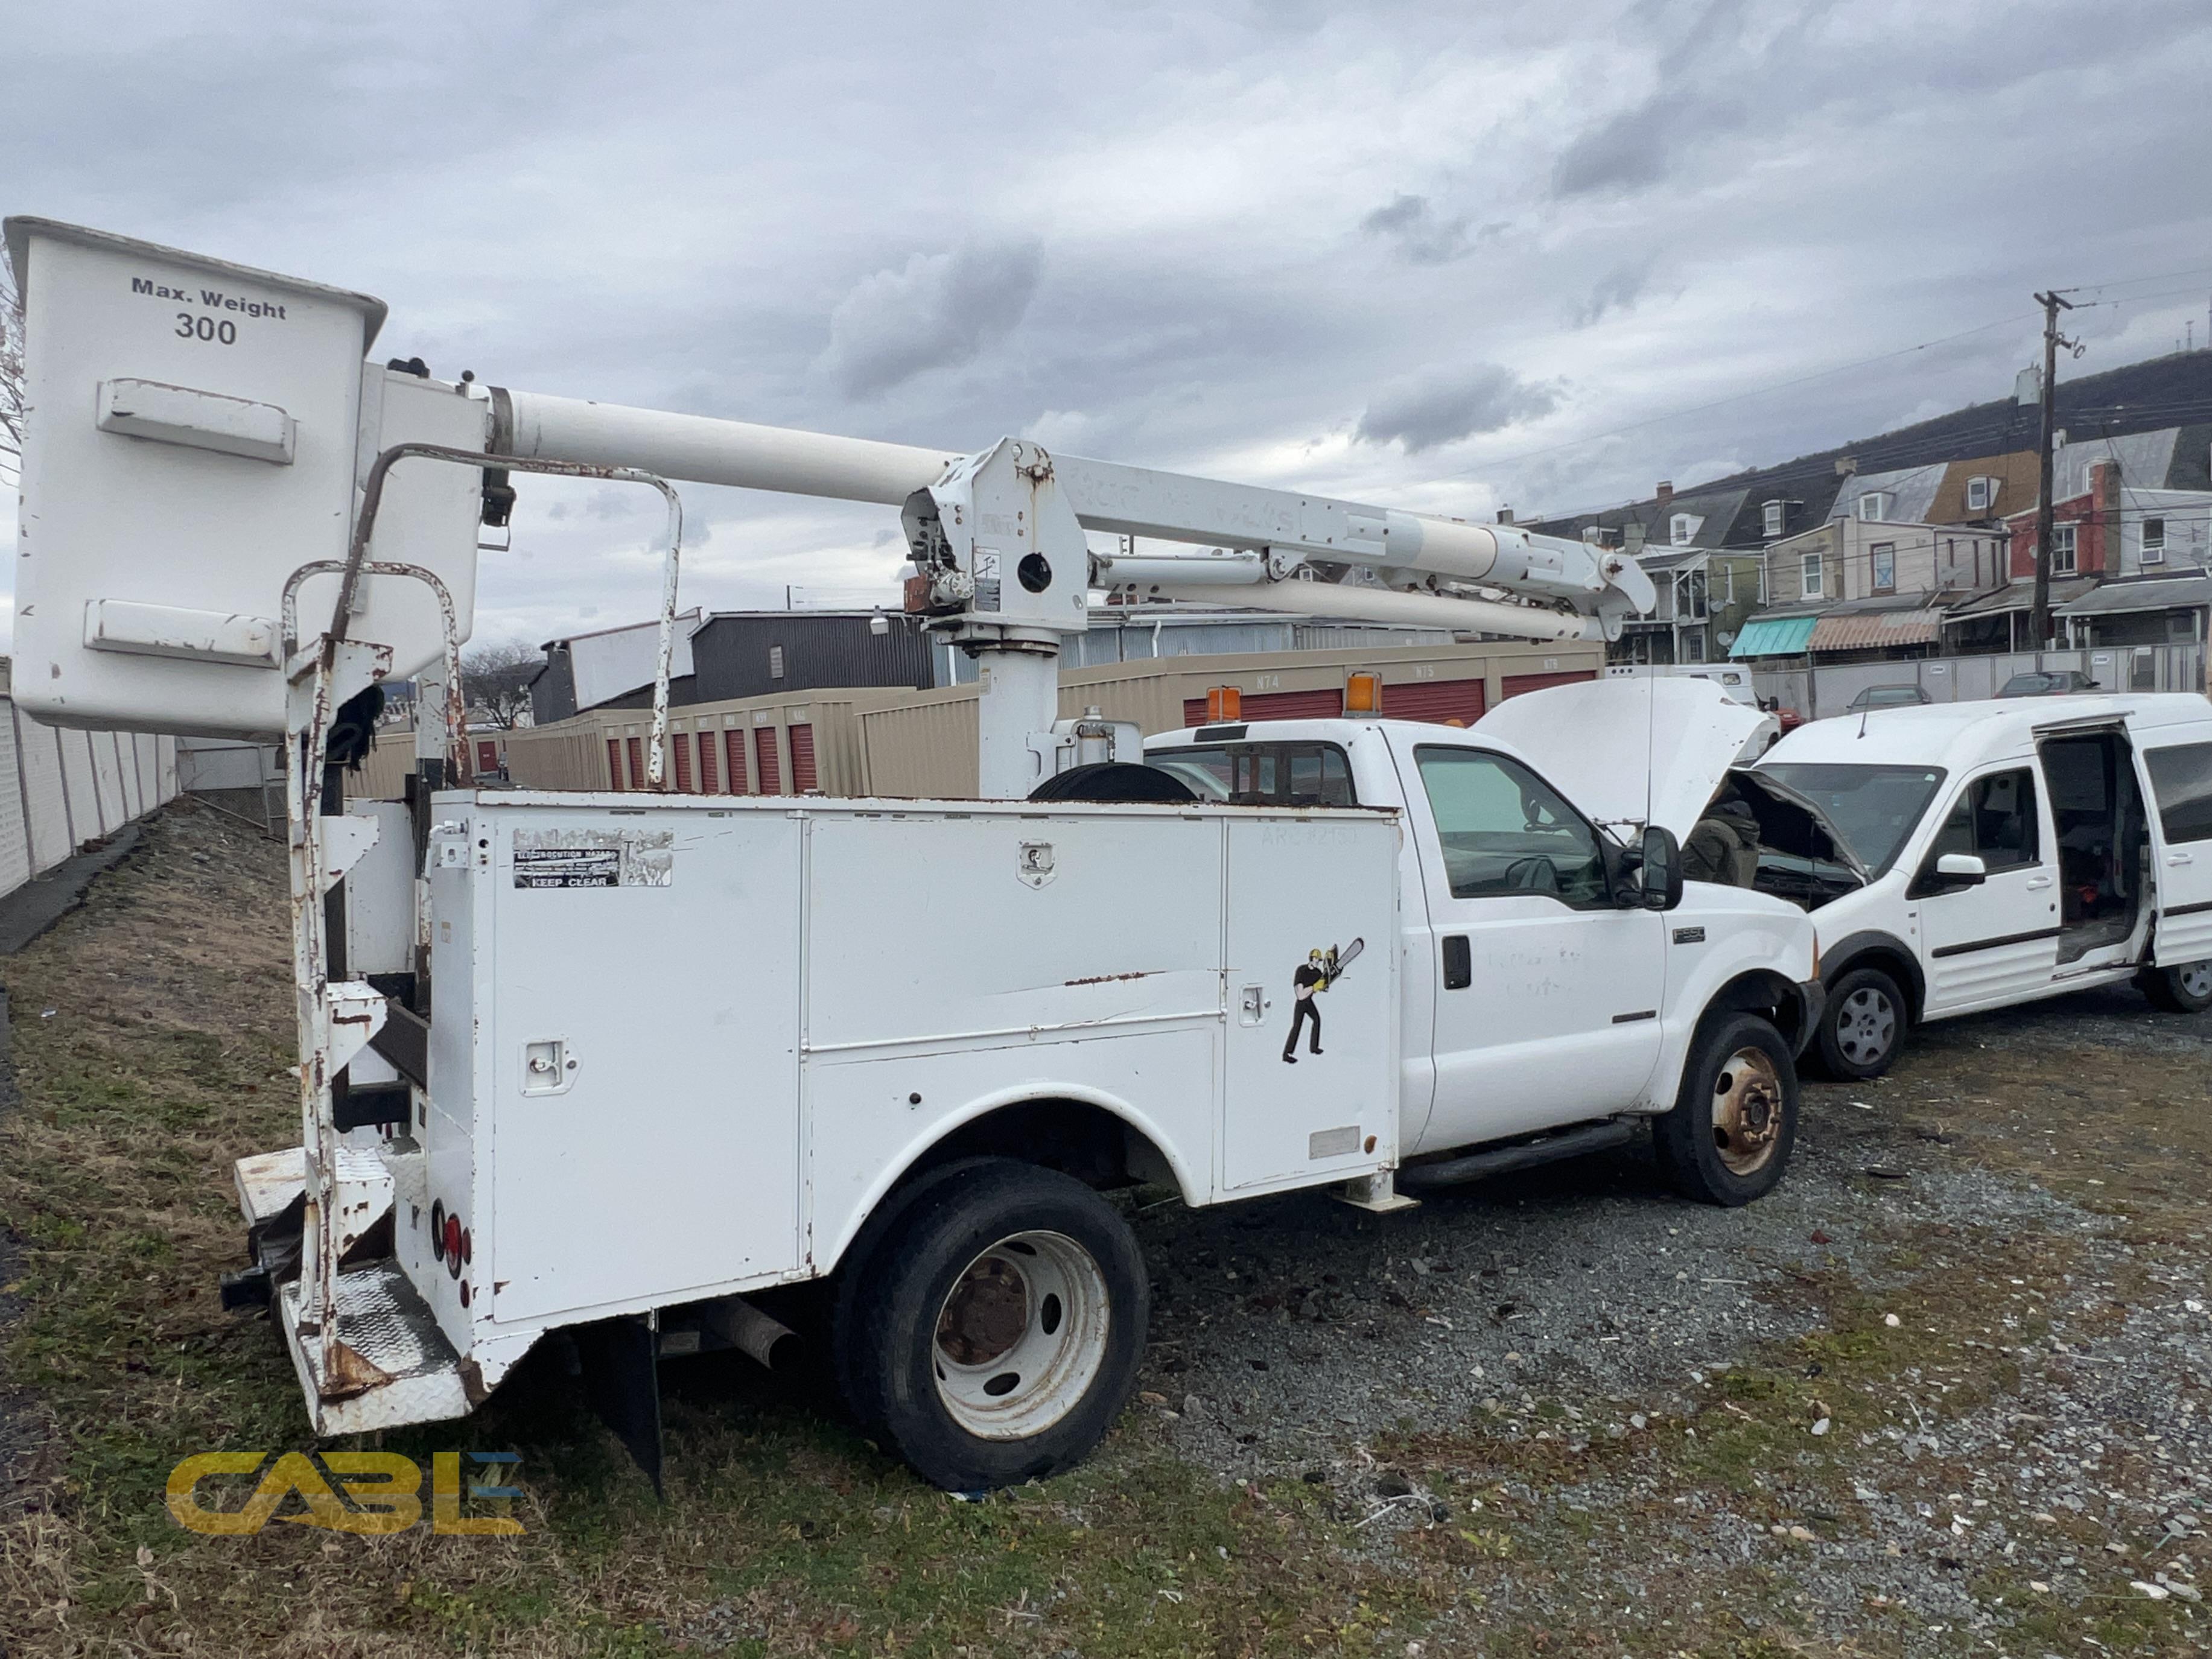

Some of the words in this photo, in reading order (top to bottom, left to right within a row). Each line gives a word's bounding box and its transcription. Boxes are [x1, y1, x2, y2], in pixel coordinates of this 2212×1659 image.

[132, 277, 193, 303] Max.
[200, 289, 287, 320] Weight
[174, 312, 237, 345] 300
[1256, 674, 1279, 690] N74
[532, 878, 563, 887] KEEP
[568, 877, 607, 887] CLEAR
